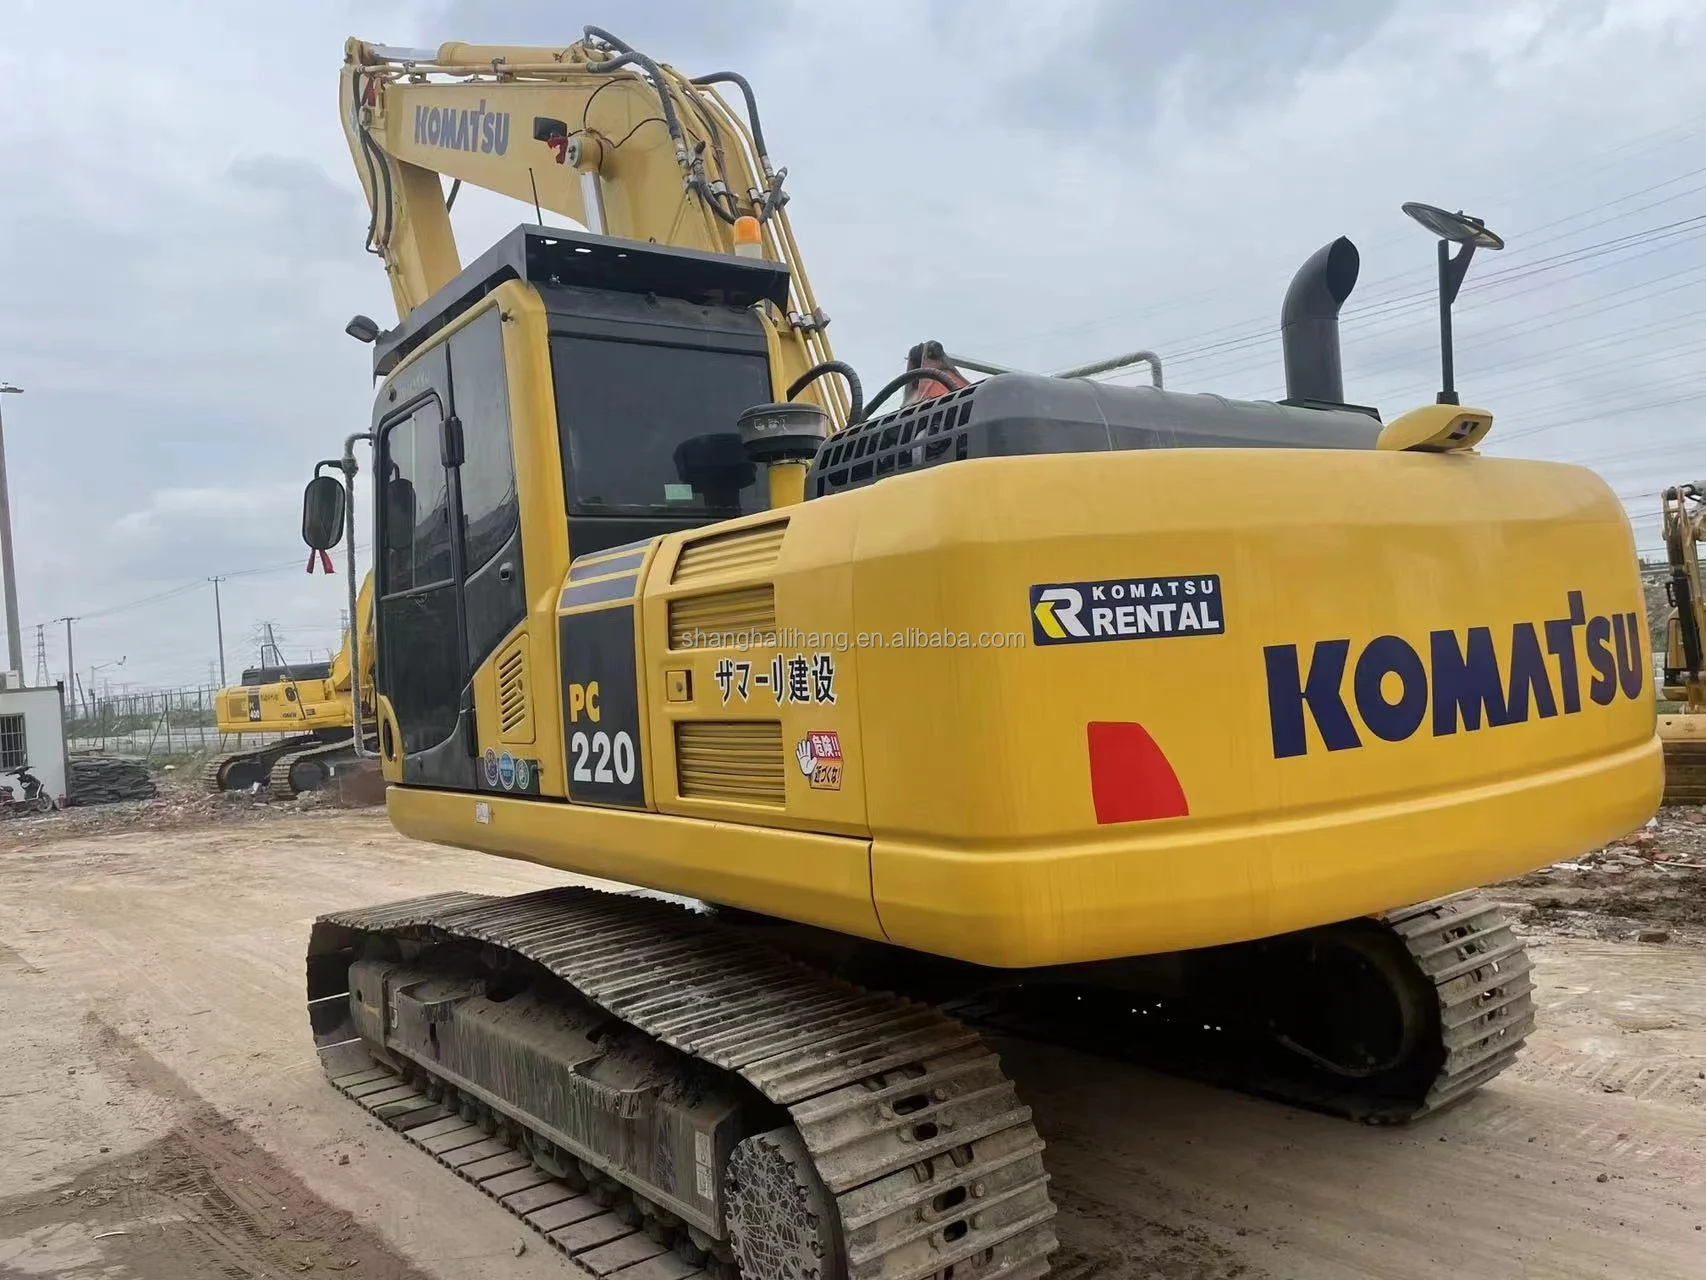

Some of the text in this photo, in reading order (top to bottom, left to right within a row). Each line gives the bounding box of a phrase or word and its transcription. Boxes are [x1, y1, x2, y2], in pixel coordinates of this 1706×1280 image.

[414, 99, 510, 156] KOMATSU
[1092, 580, 1213, 600] KOMATSU
[1092, 602, 1219, 636] RENTAL
[1263, 590, 1643, 759] KOMATSU
[569, 681, 600, 722] PC
[572, 731, 635, 784] 220
